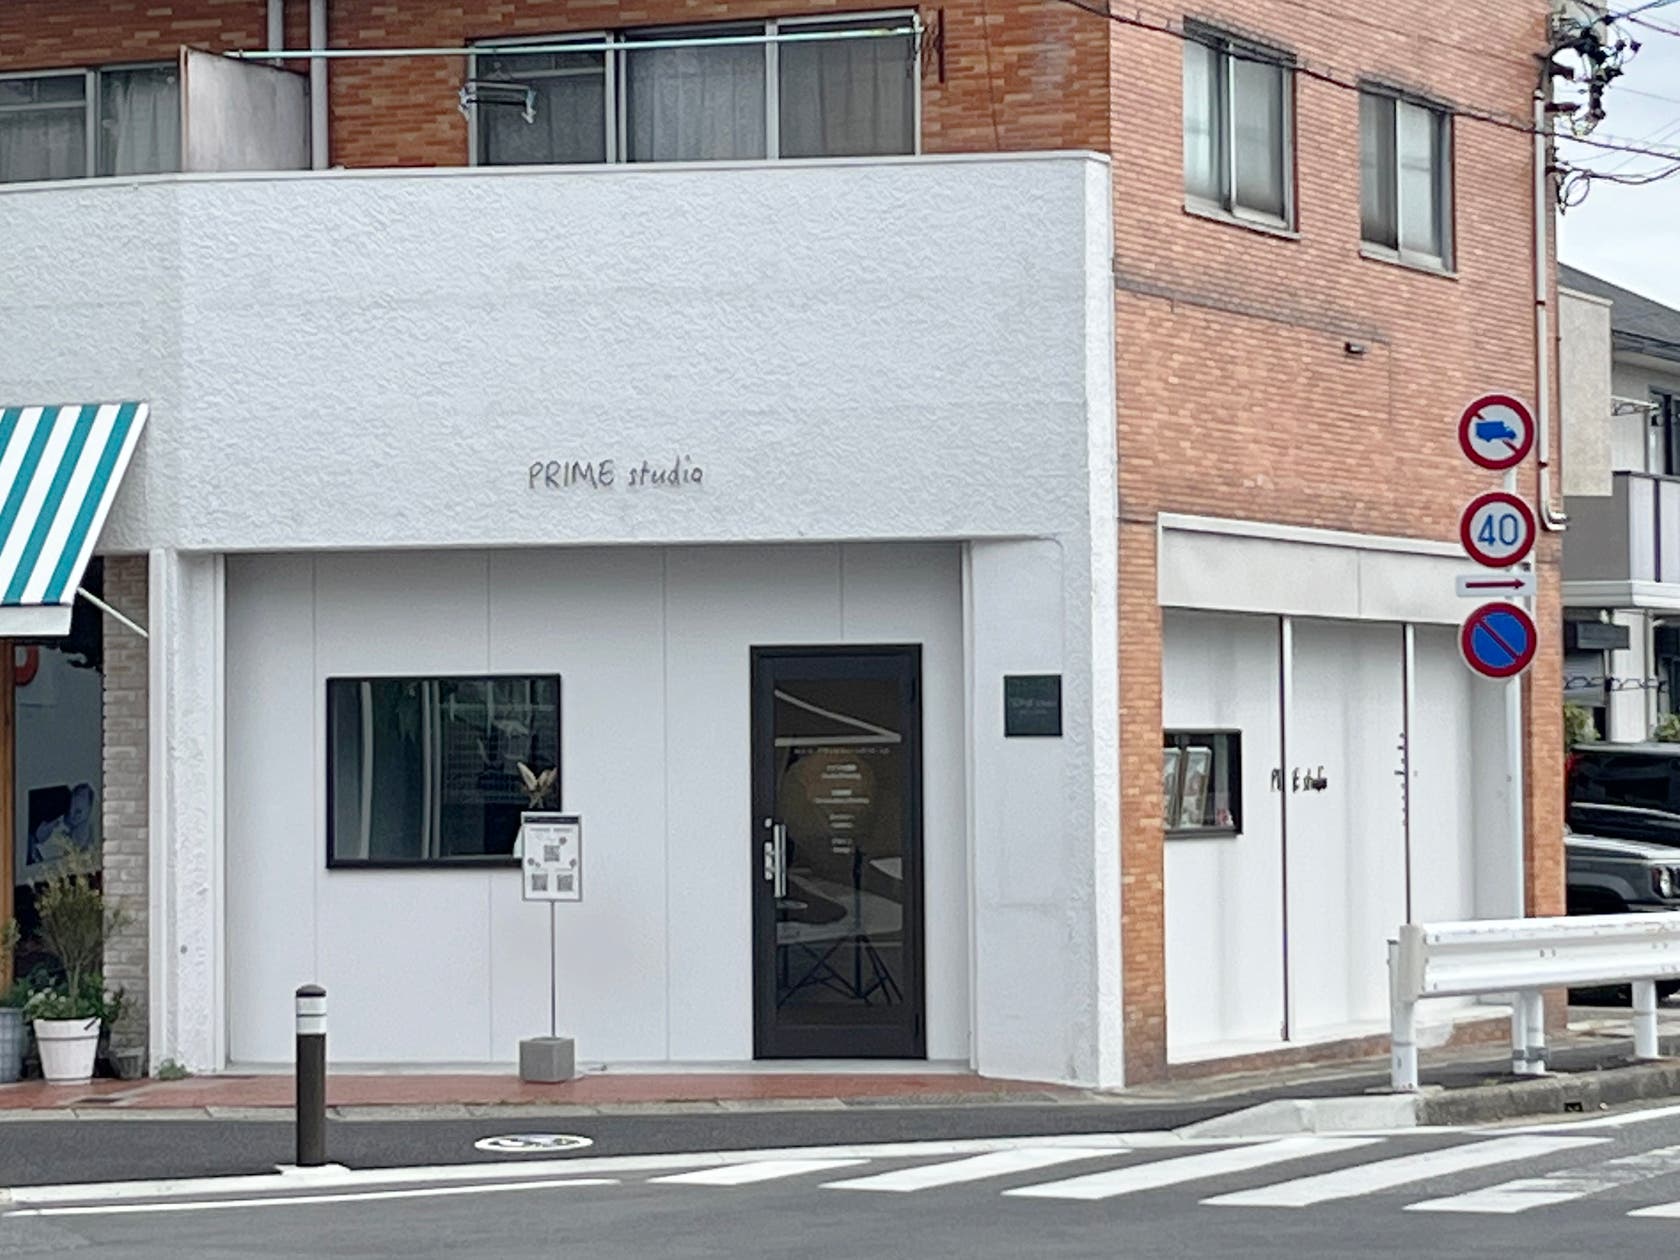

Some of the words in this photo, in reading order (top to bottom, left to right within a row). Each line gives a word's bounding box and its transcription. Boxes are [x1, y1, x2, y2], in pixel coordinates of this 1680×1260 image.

[529, 460, 614, 489] PRIME
[628, 455, 703, 487] studio
[1479, 514, 1519, 546] 40
